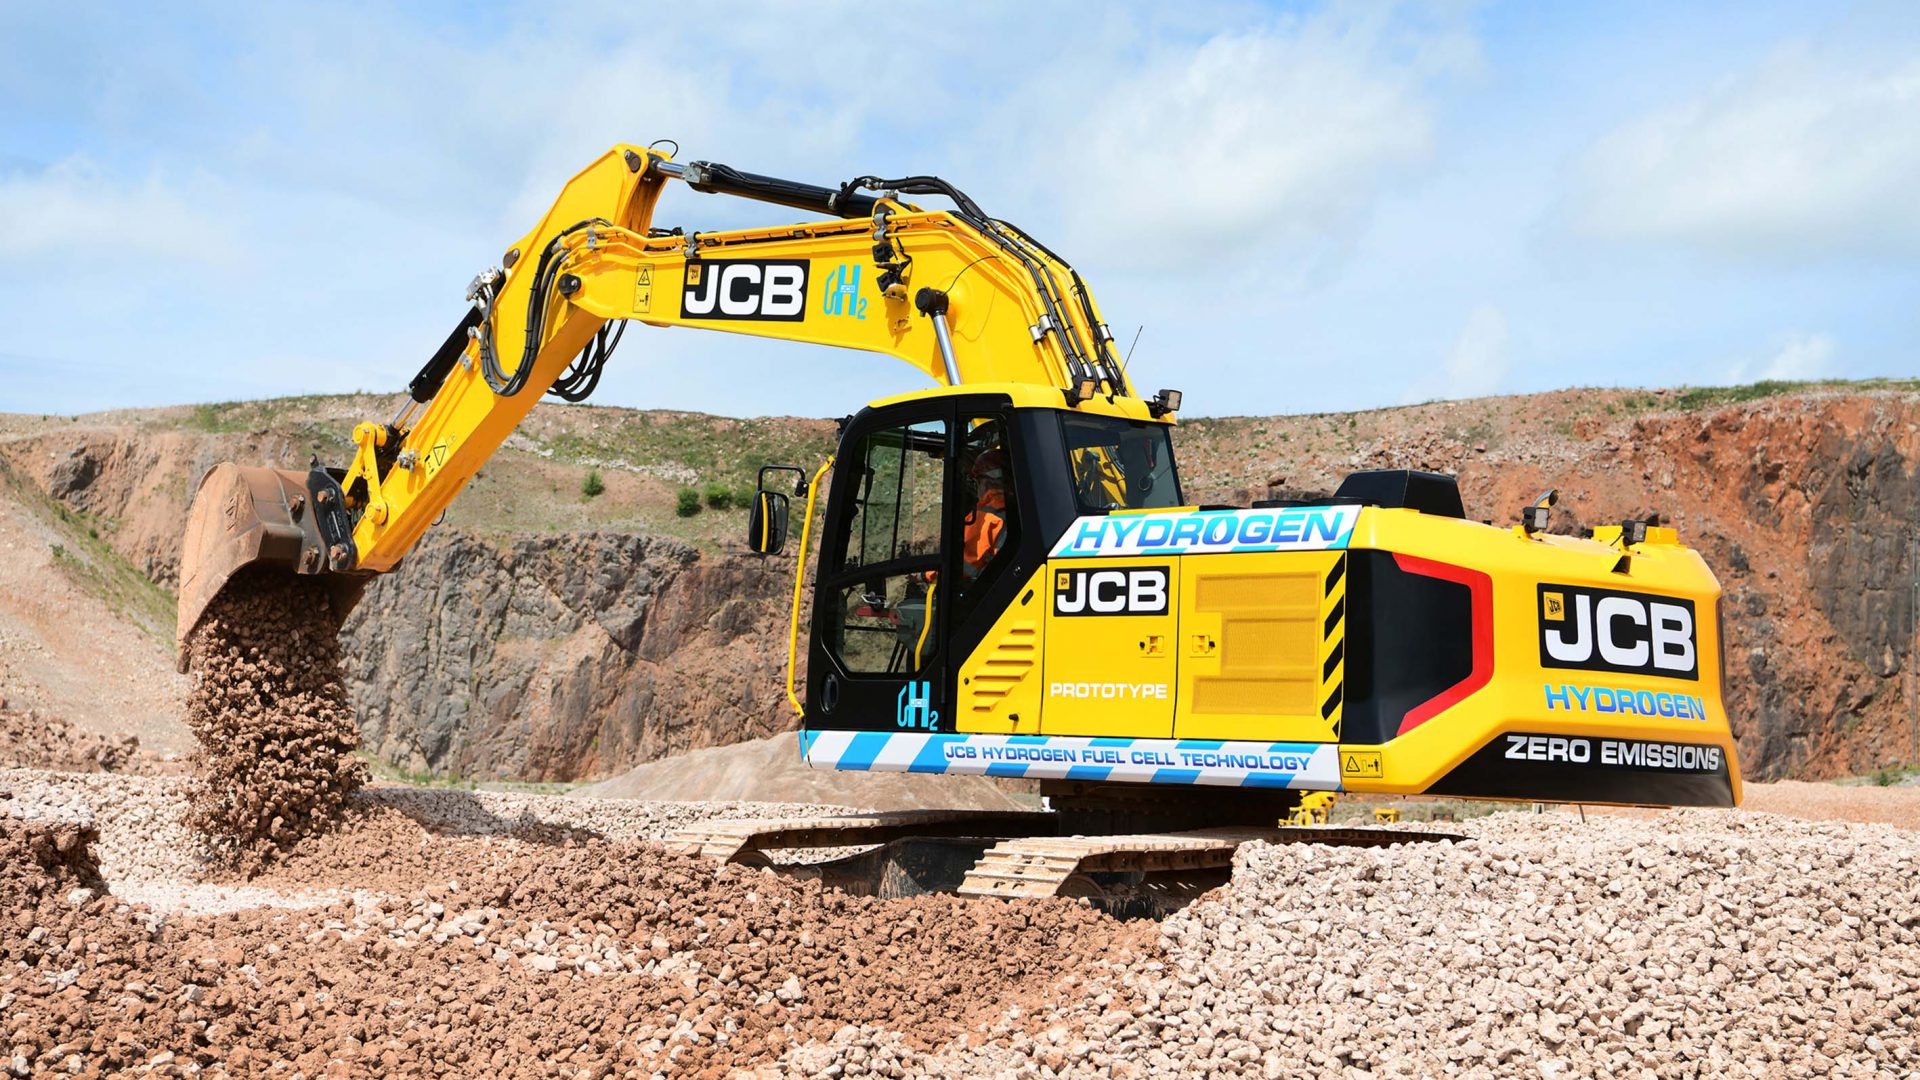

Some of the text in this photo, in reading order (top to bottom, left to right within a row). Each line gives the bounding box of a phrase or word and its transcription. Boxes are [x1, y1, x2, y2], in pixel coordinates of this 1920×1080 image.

[685, 264, 805, 316] JCB
[1073, 511, 1344, 549] HYDROGEN
[1056, 570, 1167, 613] JCB
[1545, 594, 1696, 672] JCB
[1050, 683, 1168, 700] PROTOTYPE
[1544, 684, 1706, 721] HYDROGEN
[946, 745, 1311, 771] JCB HYDROGEN FUEL CELL TECHNOLOGY
[1505, 735, 1720, 771] ZERO EMISSIONS
